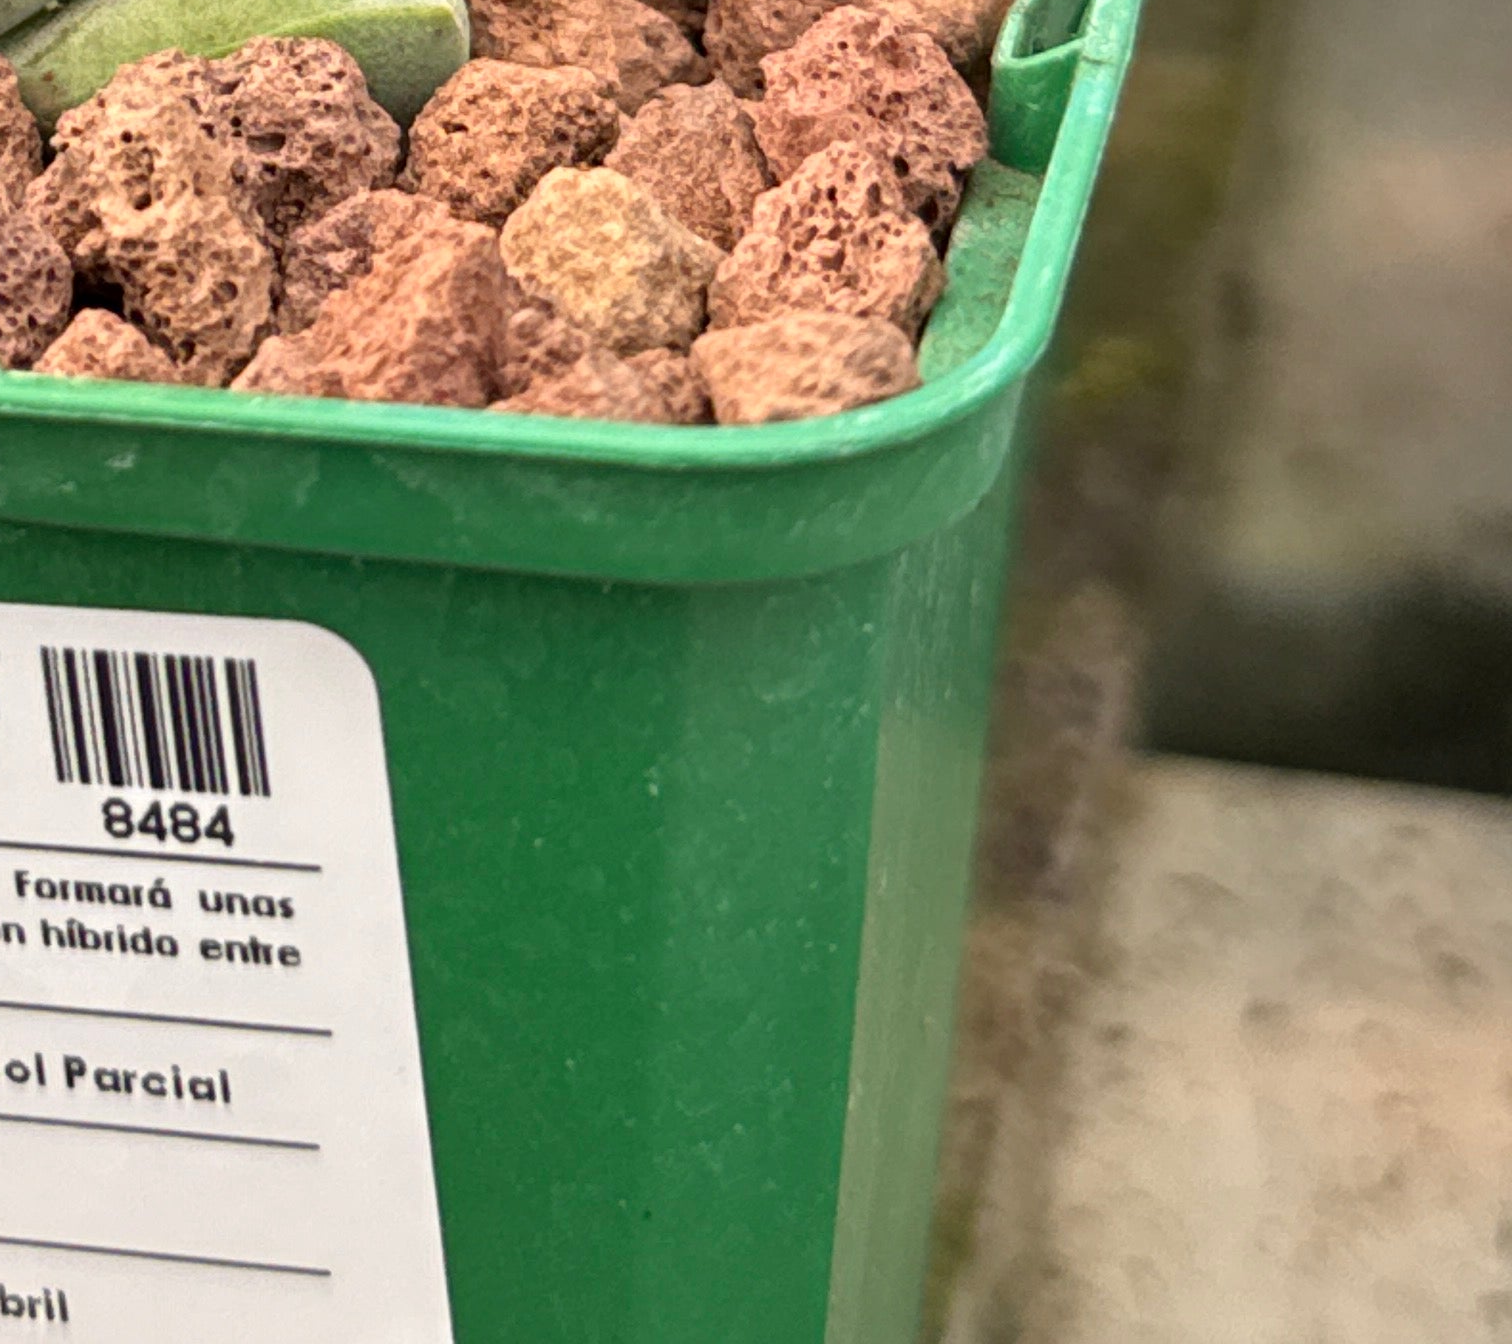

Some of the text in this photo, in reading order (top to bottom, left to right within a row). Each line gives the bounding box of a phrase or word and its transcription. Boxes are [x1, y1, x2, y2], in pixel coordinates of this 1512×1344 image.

[101, 797, 235, 848] 8484
[14, 869, 173, 910] Formará
[198, 890, 294, 919] unas
[40, 918, 179, 958] híbrido
[199, 936, 301, 967] entre
[63, 1055, 231, 1105] Parcial
